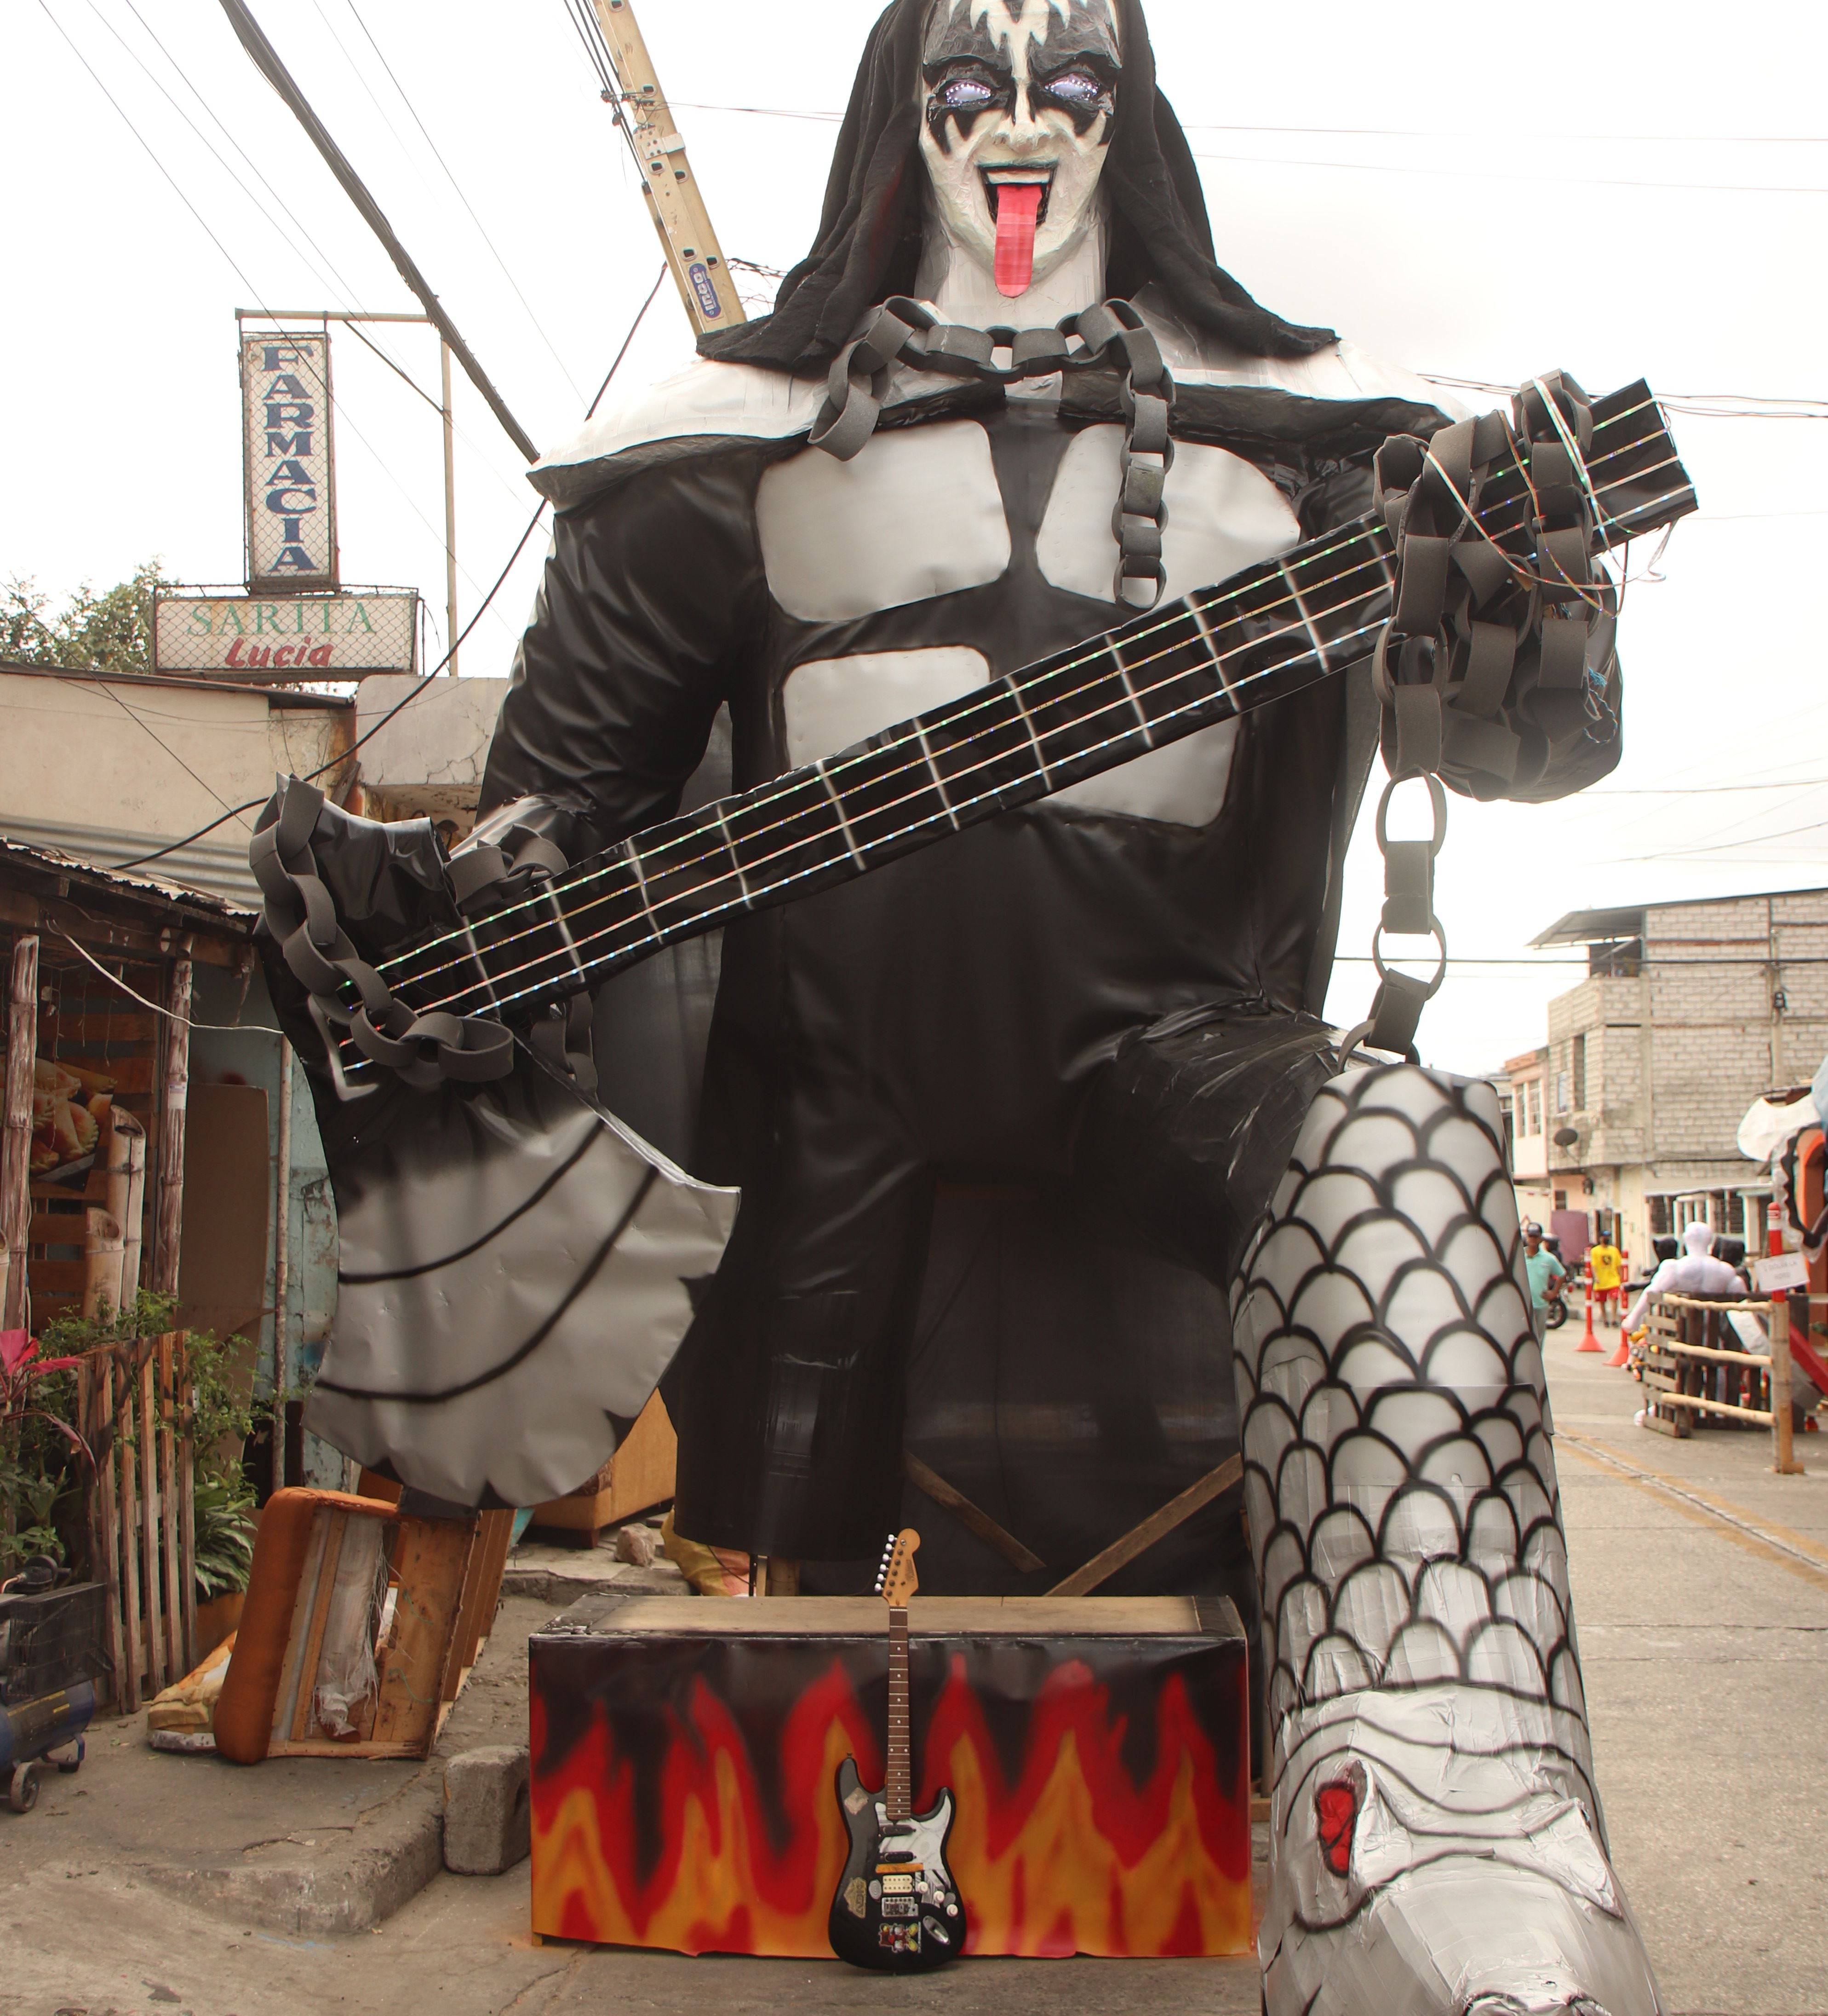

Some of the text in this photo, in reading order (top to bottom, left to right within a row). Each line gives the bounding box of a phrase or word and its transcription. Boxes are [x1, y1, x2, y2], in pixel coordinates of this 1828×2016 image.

[260, 345, 320, 572] FARMACIA
[187, 599, 376, 636] SARITA
[225, 636, 334, 667] Lucia
